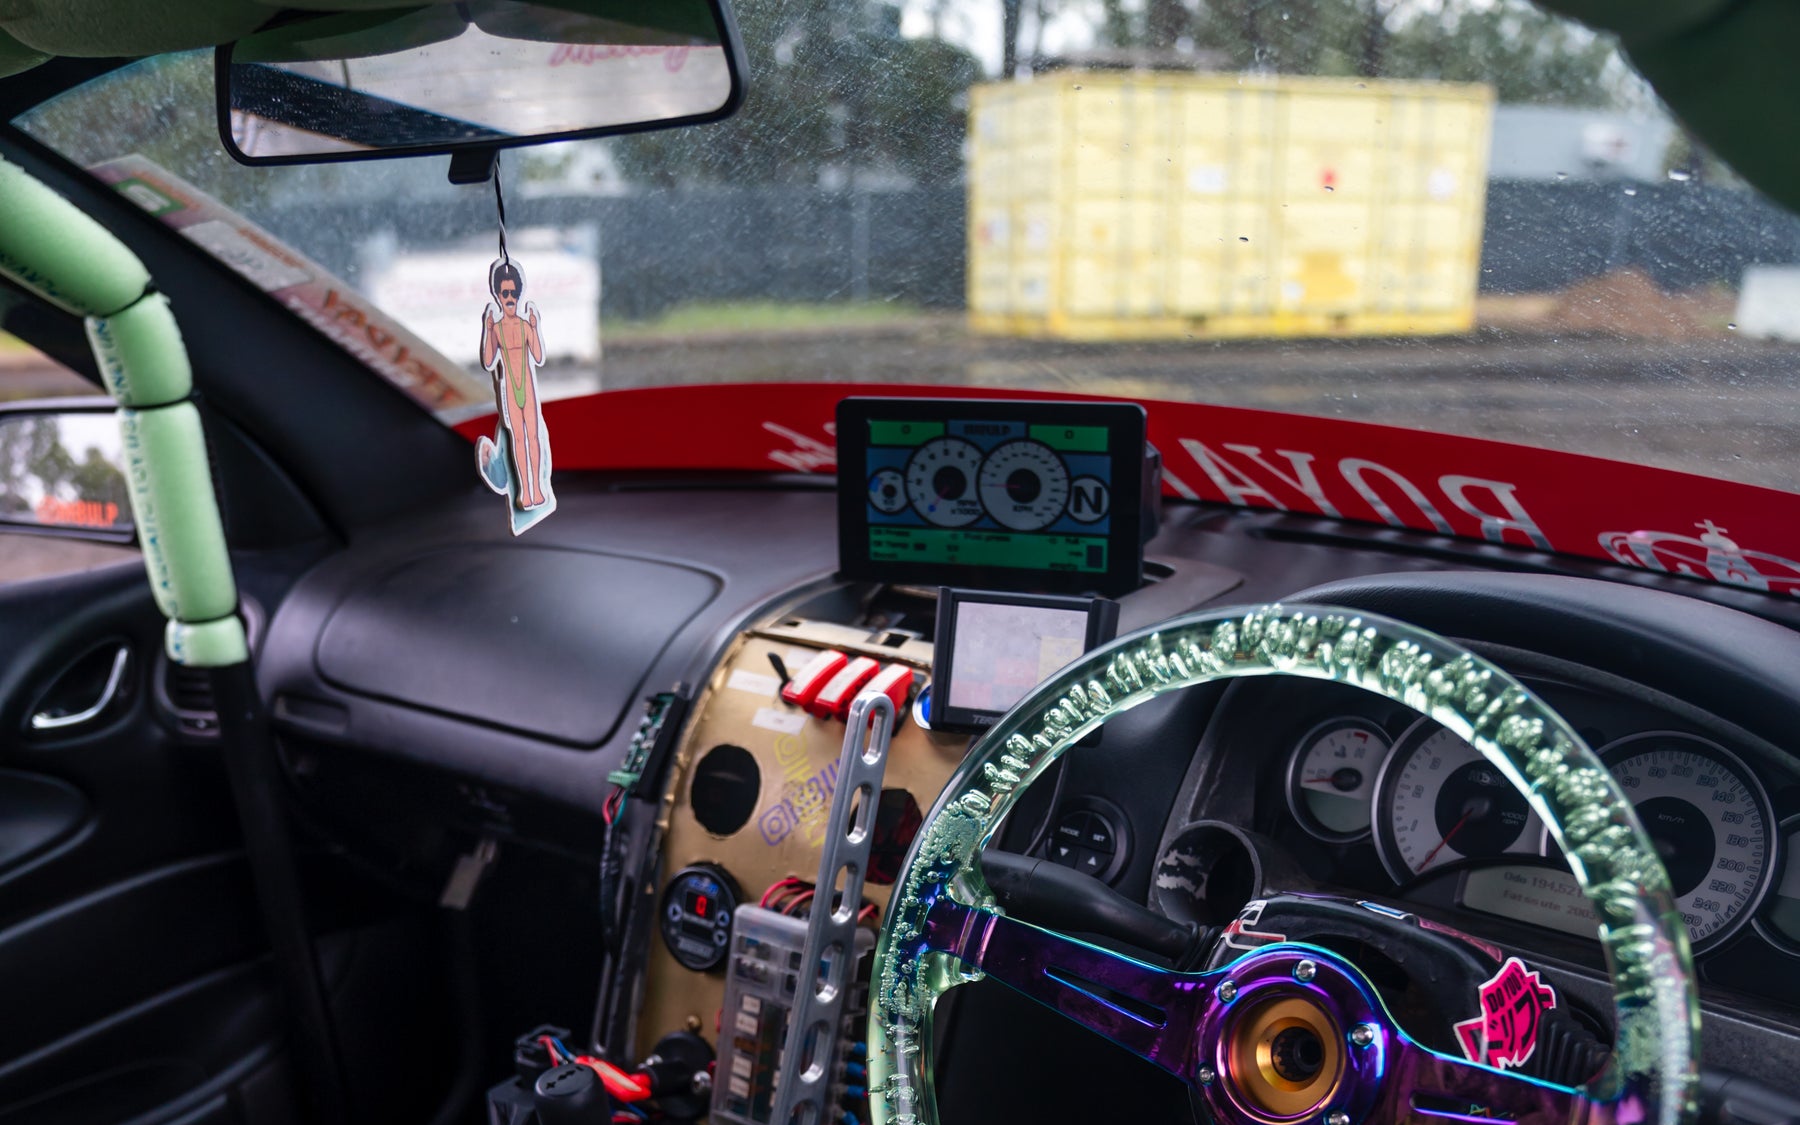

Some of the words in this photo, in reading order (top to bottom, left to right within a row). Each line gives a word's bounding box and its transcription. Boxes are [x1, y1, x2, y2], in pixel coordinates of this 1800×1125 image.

[1072, 485, 1103, 515] N
[1648, 767, 1667, 779] 80
[1672, 765, 1693, 777] 100
[1622, 775, 1641, 788] 60
[1696, 774, 1719, 788] 120
[1711, 790, 1735, 804] 140
[1657, 812, 1686, 824] km/h
[1721, 811, 1744, 824] 160
[1726, 833, 1749, 848] 180
[1717, 858, 1746, 873] 200
[1709, 879, 1736, 894] 220
[1692, 897, 1720, 912] 240
[1485, 987, 1505, 1013] DO
